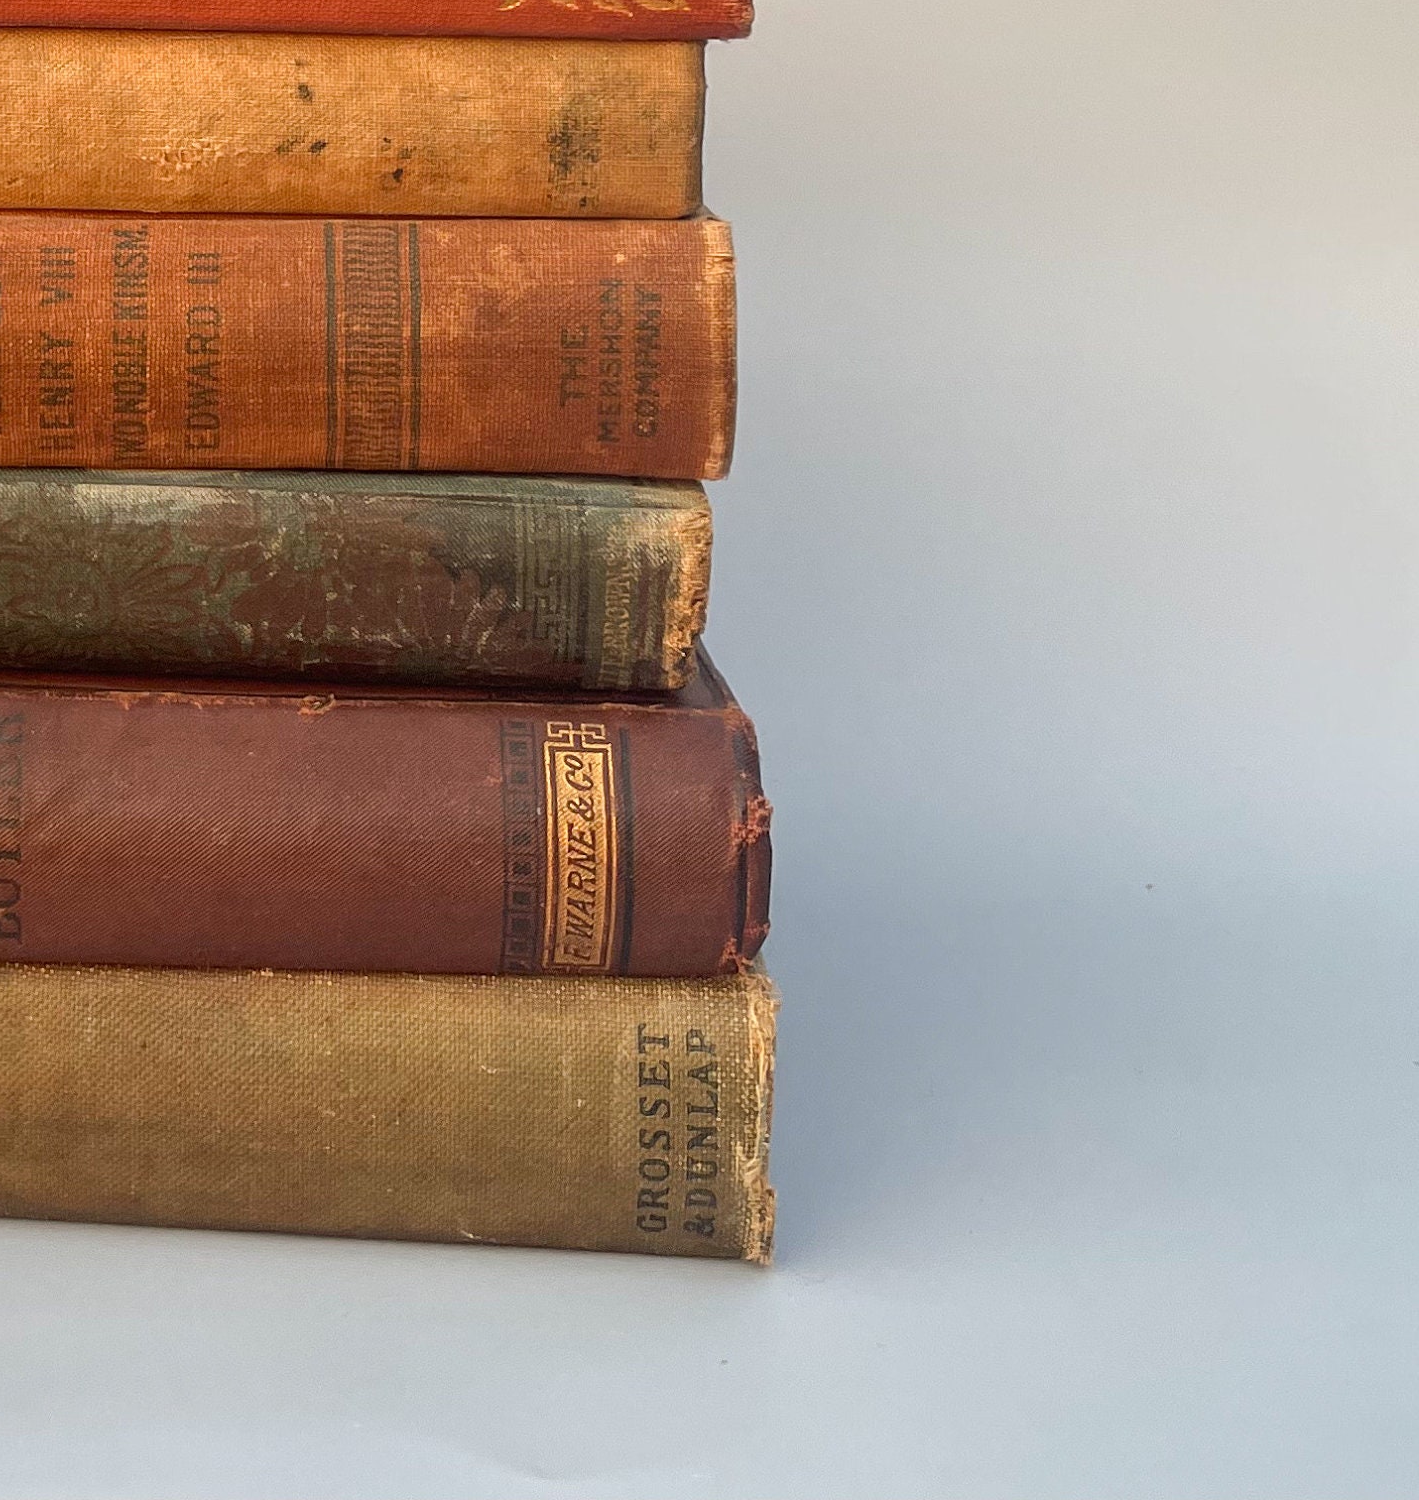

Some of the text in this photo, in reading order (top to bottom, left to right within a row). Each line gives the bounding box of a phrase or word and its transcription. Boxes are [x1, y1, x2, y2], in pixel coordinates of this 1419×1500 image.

[40, 246, 75, 450] HENRY VIII
[187, 251, 220, 450] EDWARD III
[560, 325, 589, 408] THE
[597, 279, 624, 444] MERSHON
[565, 799, 595, 822] &
[565, 821, 597, 939] WARNE
[636, 1022, 671, 1233] GROSSET
